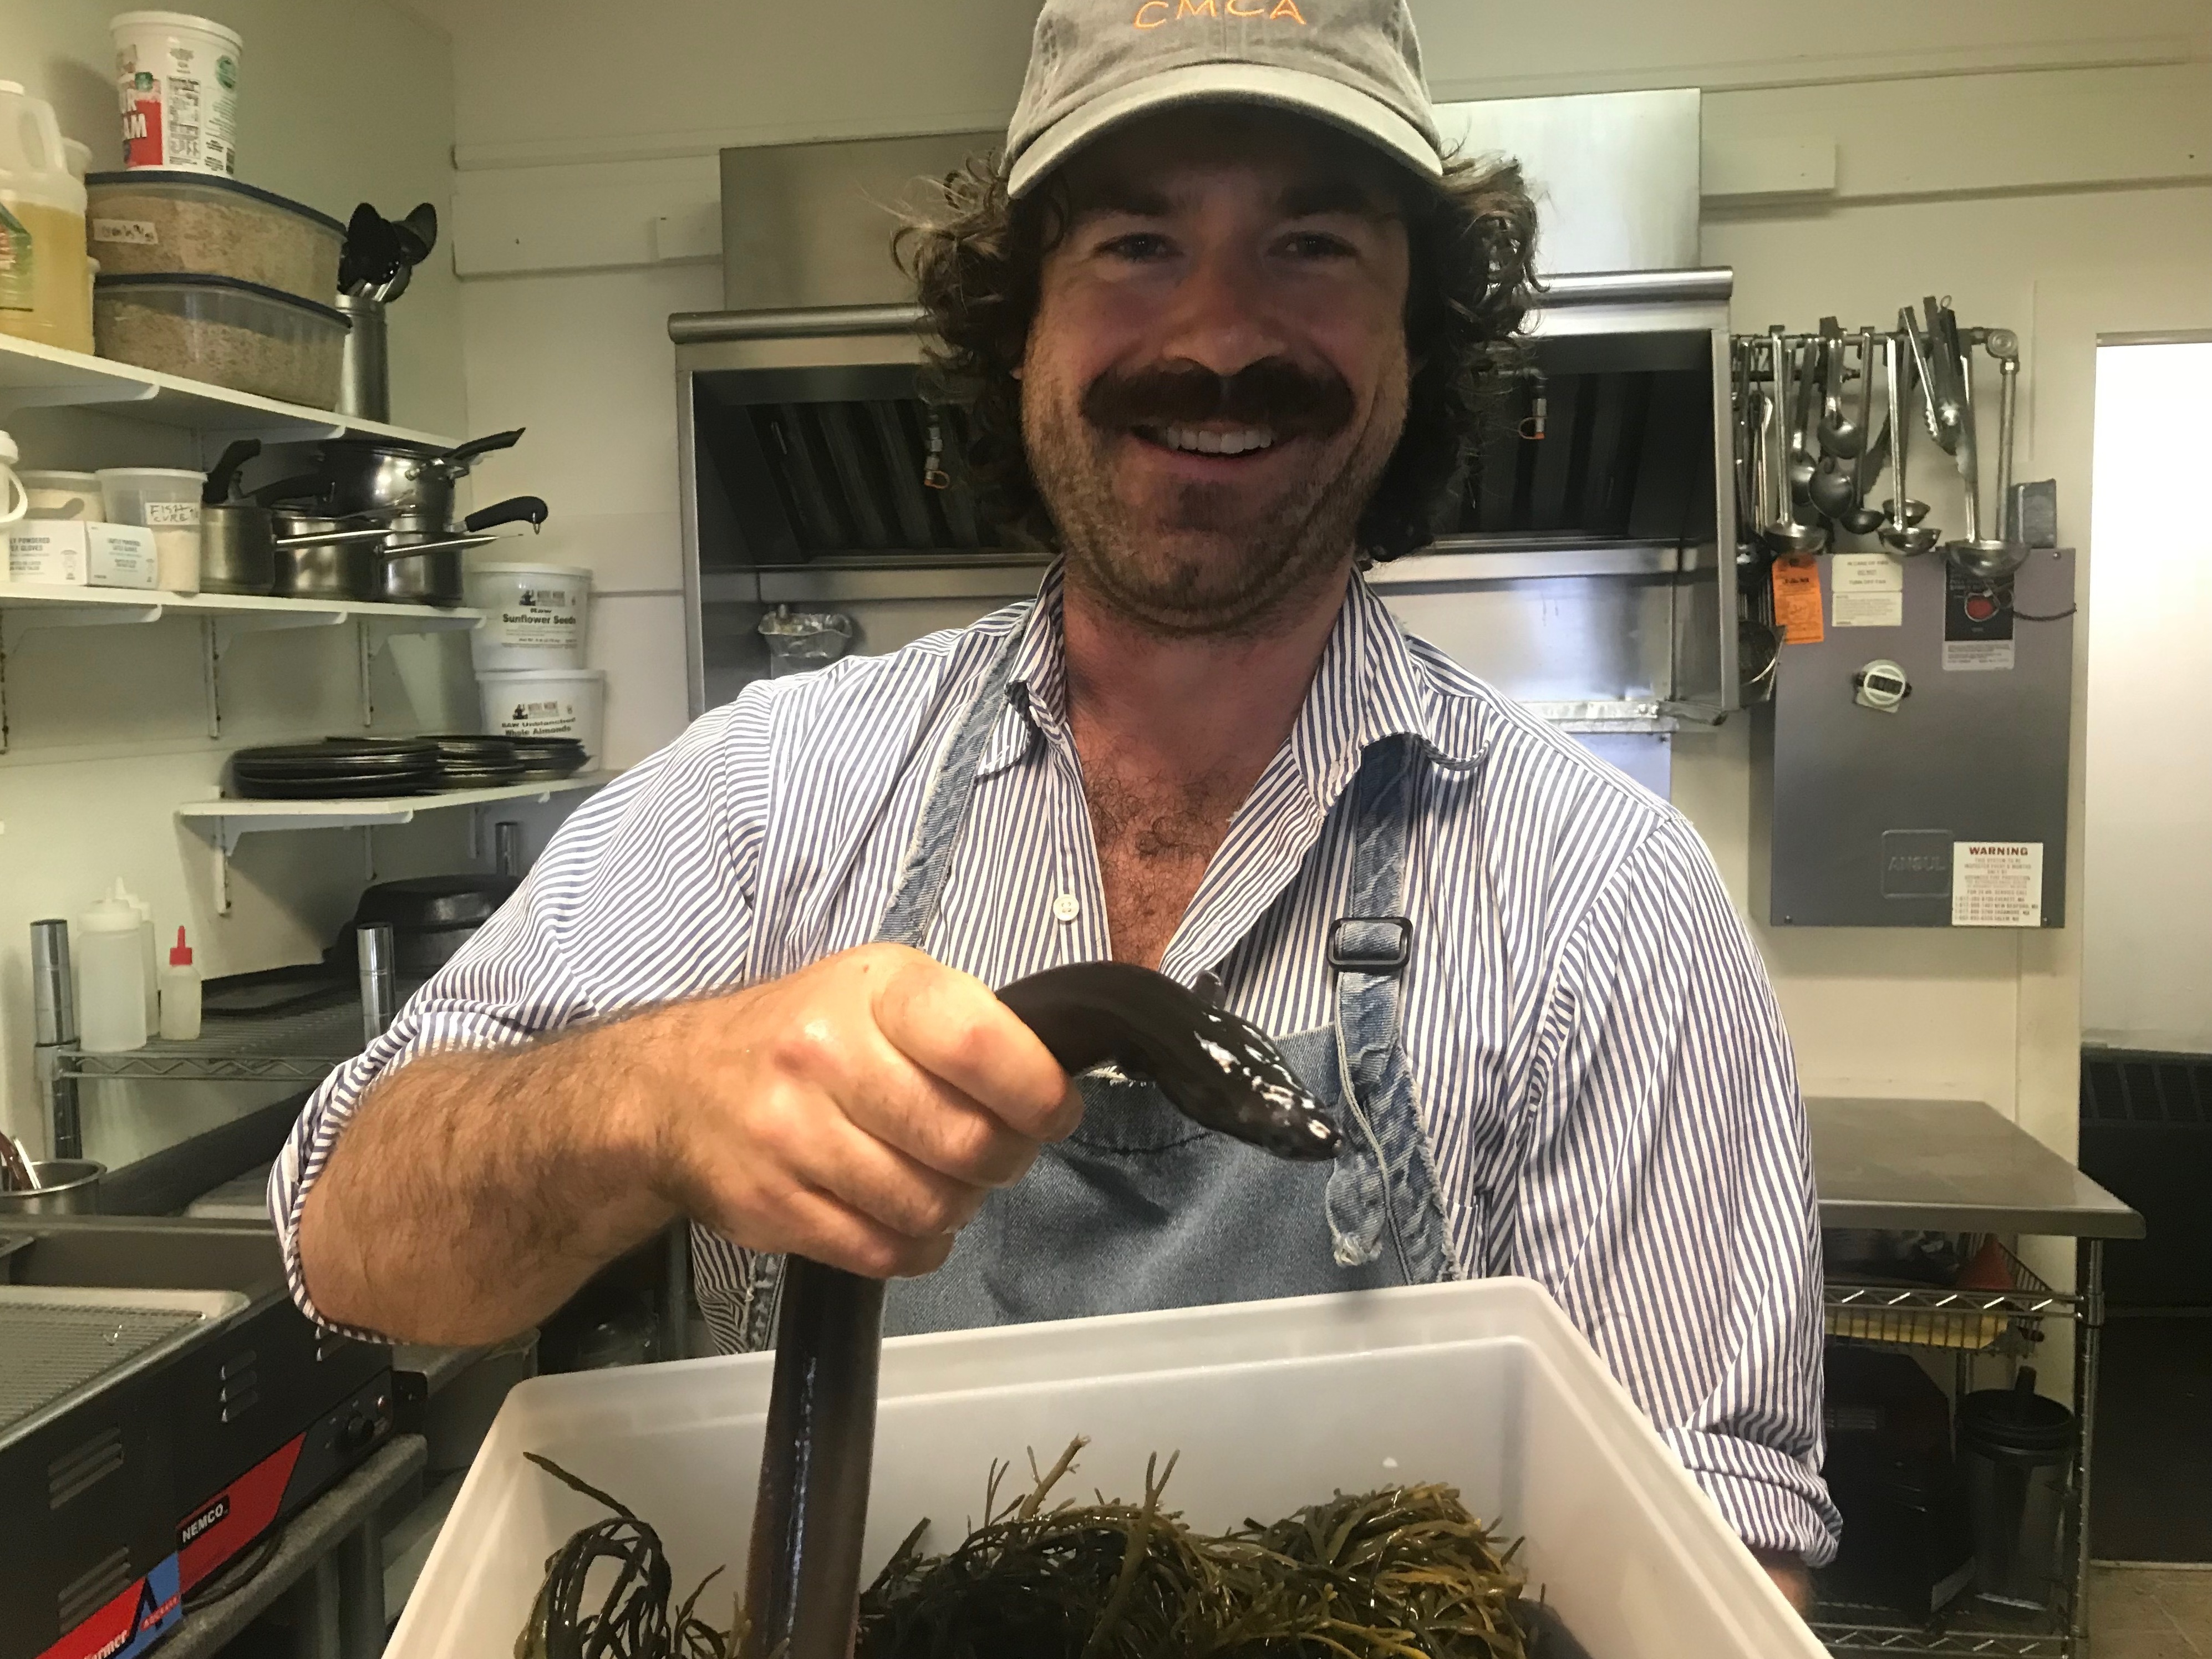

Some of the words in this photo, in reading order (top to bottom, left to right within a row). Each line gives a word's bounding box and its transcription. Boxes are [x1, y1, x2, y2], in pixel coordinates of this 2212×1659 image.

[150, 505, 190, 516] FISH
[154, 513, 189, 522] CURE
[503, 613, 551, 624] Sunflower
[533, 725, 572, 735] Almonds
[1969, 846, 2028, 856] WARNING
[182, 1503, 224, 1543] NEMCO
